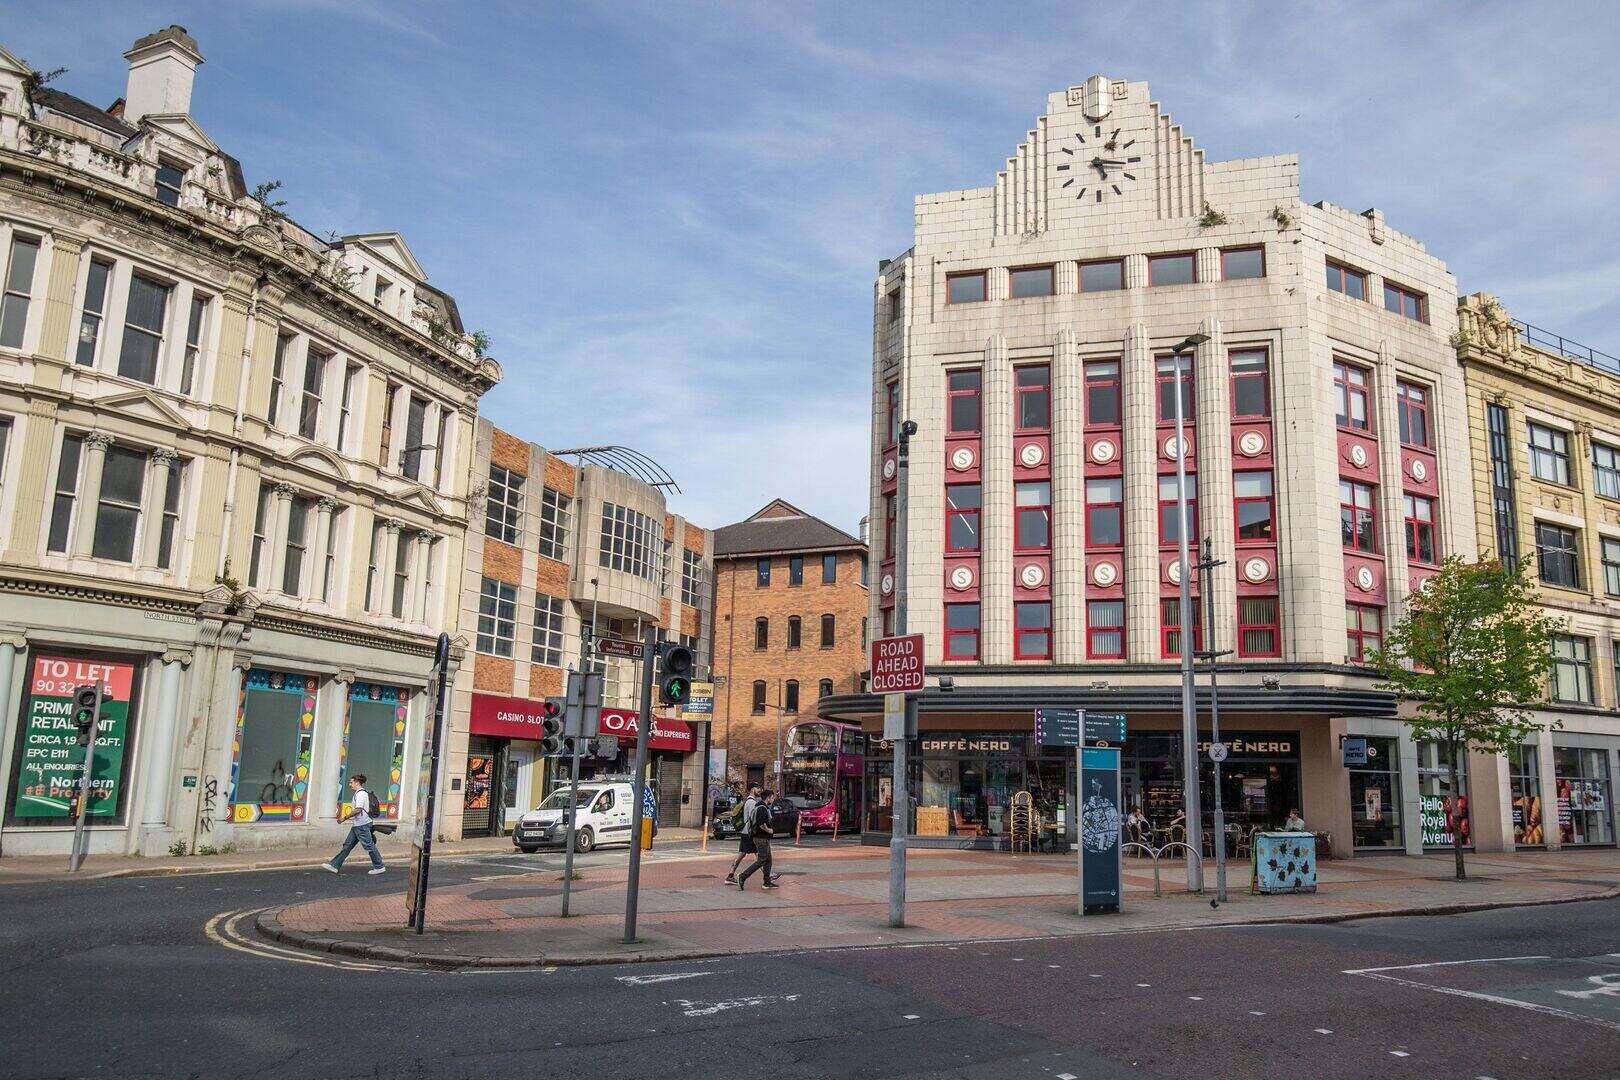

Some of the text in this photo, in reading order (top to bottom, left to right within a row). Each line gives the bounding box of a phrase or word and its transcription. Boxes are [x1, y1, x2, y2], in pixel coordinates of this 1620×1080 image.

[145, 611, 196, 624] NORTH STREET
[881, 641, 913, 657] ROAD
[40, 660, 115, 681] TO LET
[877, 656, 918, 673] AHEAD
[36, 680, 54, 692] 90
[873, 672, 921, 689] CLOSED
[497, 711, 525, 723] CASINO
[29, 734, 61, 744] CIRCA
[664, 730, 690, 740] EXPERIENCE
[922, 737, 1010, 751] CAFFÈ NERO
[1245, 742, 1291, 752] NERO
[27, 749, 69, 758] EPC E111
[50, 776, 114, 788] Nortern
[1419, 797, 1444, 811] Hello
[1420, 813, 1447, 830] Royal
